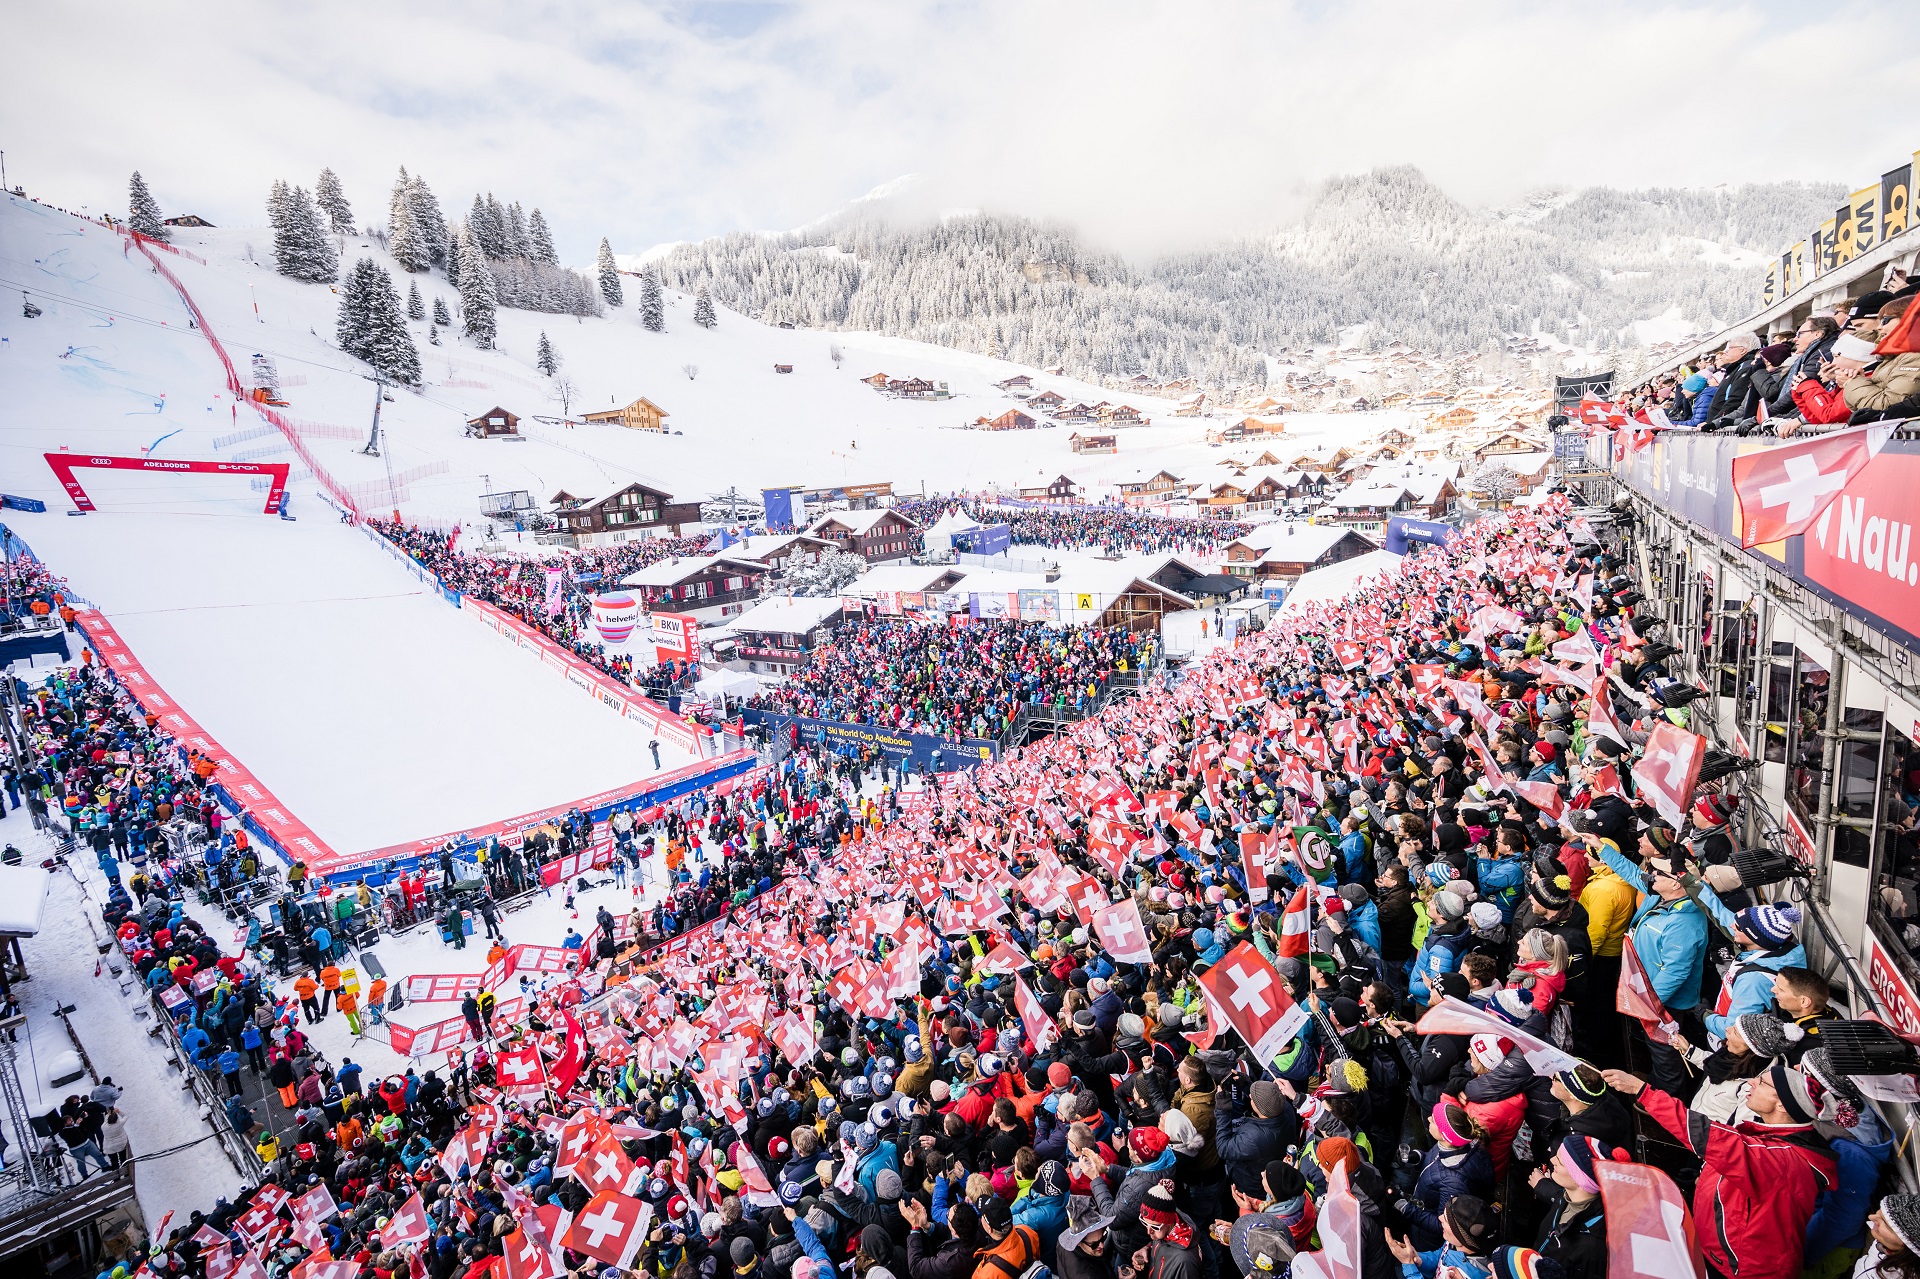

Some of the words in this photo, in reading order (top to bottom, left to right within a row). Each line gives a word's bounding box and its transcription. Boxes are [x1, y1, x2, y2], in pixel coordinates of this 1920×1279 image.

[144, 461, 190, 469] ADELBODEN
[1081, 598, 1090, 609] A
[606, 614, 636, 623] helvetia
[661, 620, 679, 631] BKW
[603, 694, 621, 711] BKW
[801, 723, 816, 732] Audi
[827, 726, 838, 735] Ski
[839, 728, 858, 738] World
[860, 731, 874, 742] Cup
[874, 733, 912, 747] Adelboden
[940, 743, 979, 753] ADELBODEN
[1872, 958, 1896, 1010] SRG
